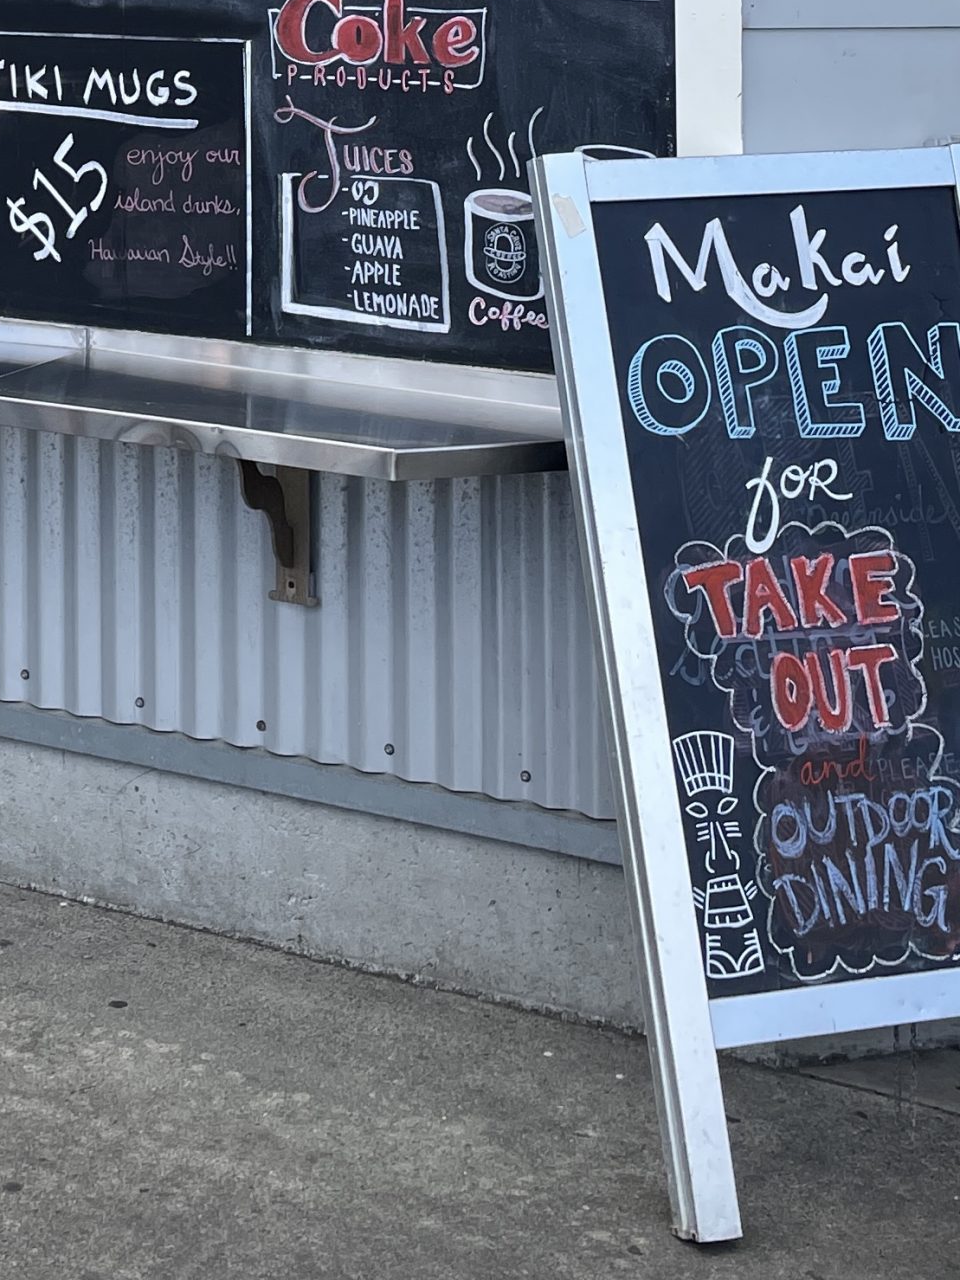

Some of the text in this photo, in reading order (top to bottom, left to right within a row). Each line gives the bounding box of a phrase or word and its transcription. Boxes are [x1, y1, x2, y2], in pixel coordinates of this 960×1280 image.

[82, 67, 198, 106] MUGS
[5, 132, 108, 263] $15
[113, 187, 177, 214] island
[126, 146, 240, 186] enjoy our
[643, 204, 911, 330] Makai
[627, 321, 960, 442] OPEN
[682, 550, 901, 642] TAKE
[770, 643, 899, 734] OUT
[800, 732, 877, 787] and
[770, 785, 960, 860] OUTDOOR
[773, 840, 950, 938] DINING
